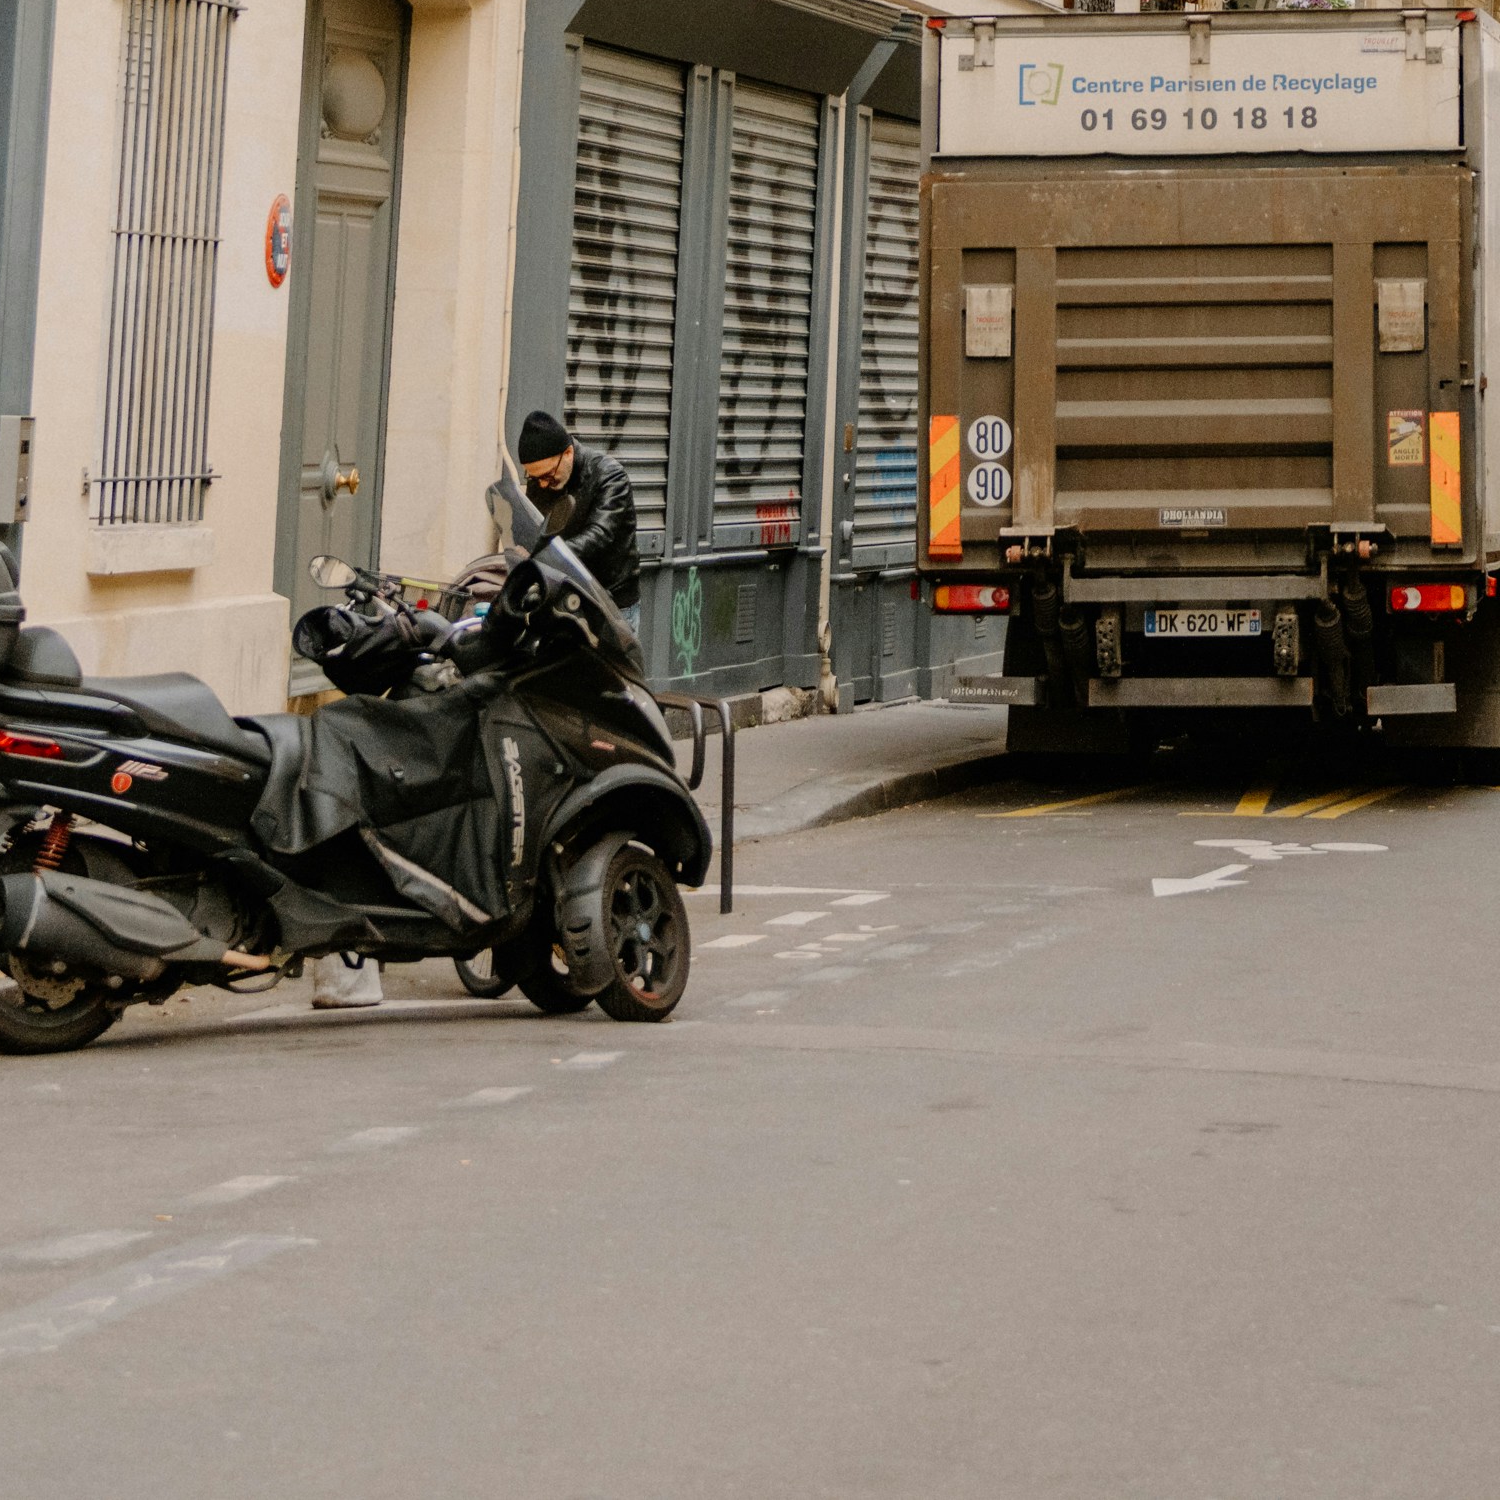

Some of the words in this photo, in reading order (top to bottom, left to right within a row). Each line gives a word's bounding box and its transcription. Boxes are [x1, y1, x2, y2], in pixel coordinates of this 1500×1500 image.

[1072, 77, 1144, 93] Centre
[1150, 75, 1236, 92] Parisien
[1242, 75, 1266, 91] de
[1273, 73, 1377, 94] Recyclage
[1081, 108, 1113, 131] 01
[1131, 108, 1167, 131] 69
[1183, 107, 1218, 130] 10
[1233, 107, 1267, 130] 18
[1283, 106, 1318, 129] 18
[976, 421, 1003, 454] 80
[976, 467, 1003, 500] 90
[1163, 510, 1223, 520] DHOLLANDIA
[1158, 613, 1246, 632] DK-620-WF
